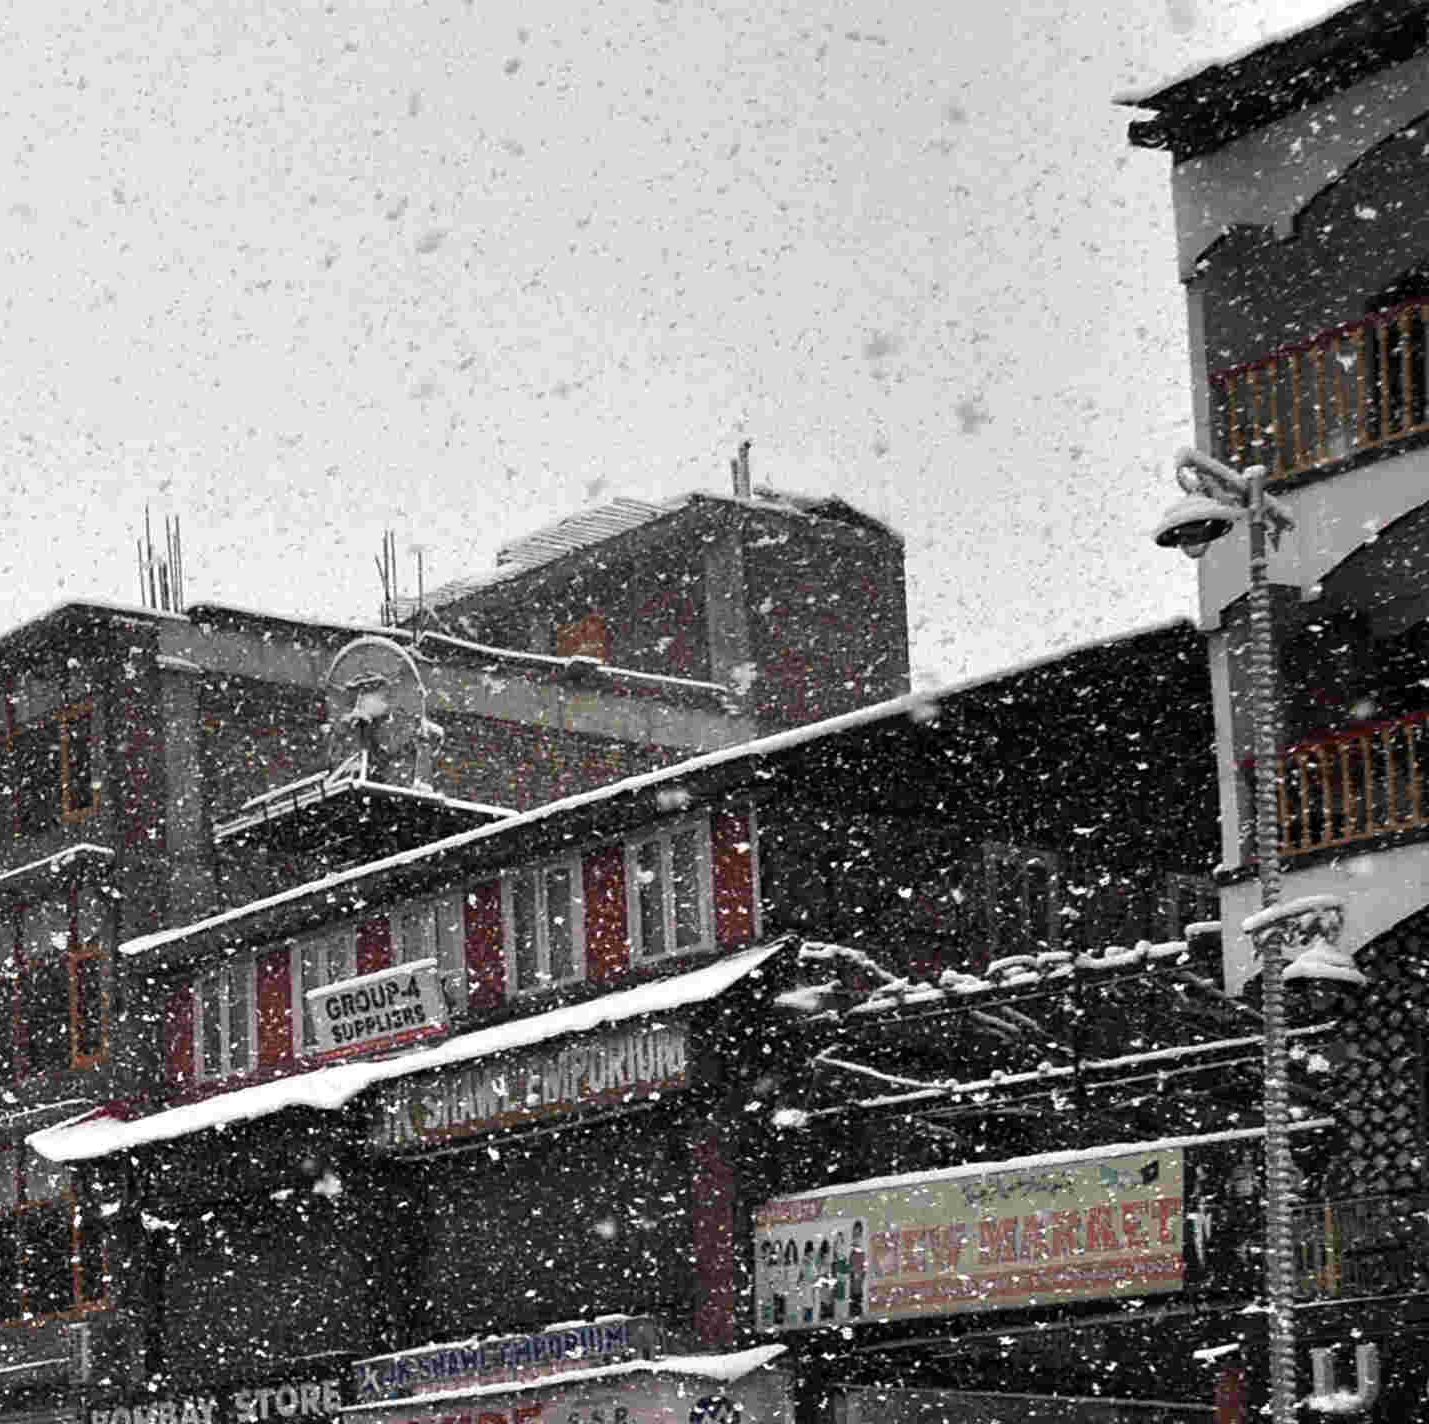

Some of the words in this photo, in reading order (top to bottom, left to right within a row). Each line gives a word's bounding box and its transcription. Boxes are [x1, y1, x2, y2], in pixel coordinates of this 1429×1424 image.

[326, 976, 420, 1020] GROUP-4
[331, 1004, 426, 1042] SUPPLIERS
[978, 1198, 1181, 1265] MARKET
[500, 1328, 630, 1368] EMPORIUM
[234, 1380, 341, 1423] STORE
